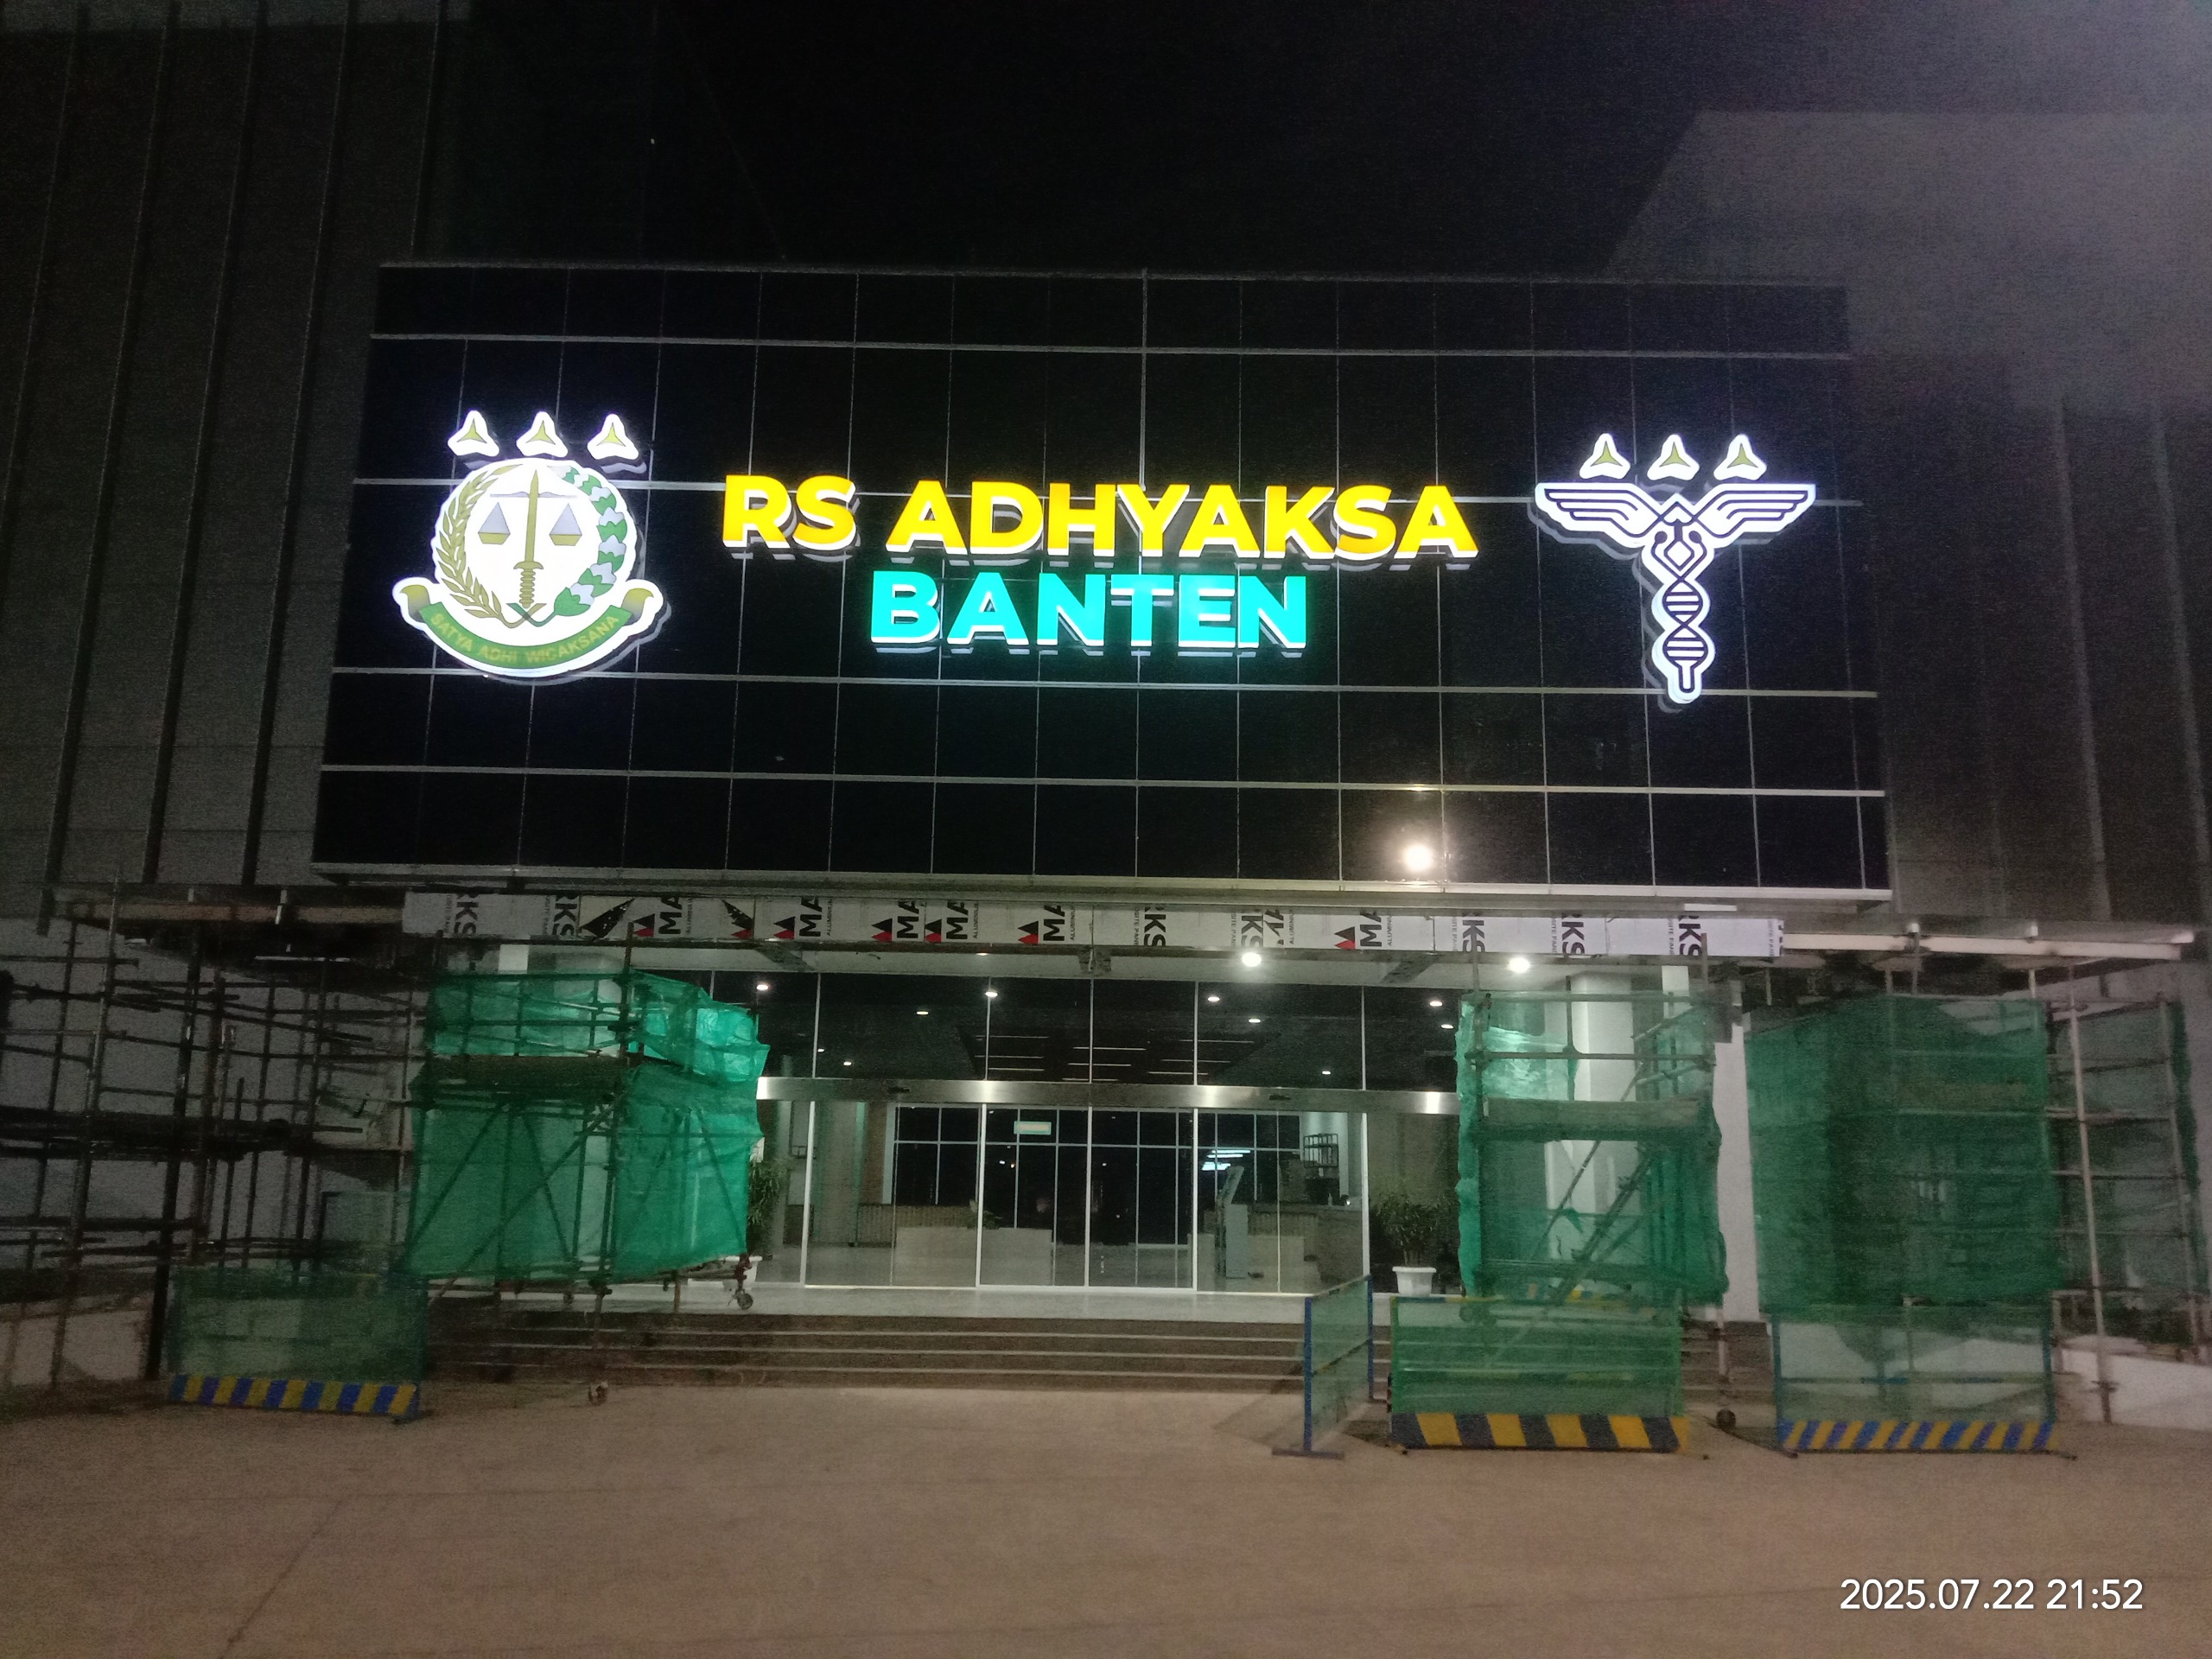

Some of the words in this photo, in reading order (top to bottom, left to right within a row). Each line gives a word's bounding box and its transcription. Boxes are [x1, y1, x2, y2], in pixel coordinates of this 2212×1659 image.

[722, 474, 856, 551] RS
[885, 480, 1479, 560] ADHYAKSA
[430, 613, 474, 652] SATYA
[478, 647, 518, 664] ADHI
[524, 615, 620, 664] WICAKSANA
[870, 570, 1306, 649] BANTEN
